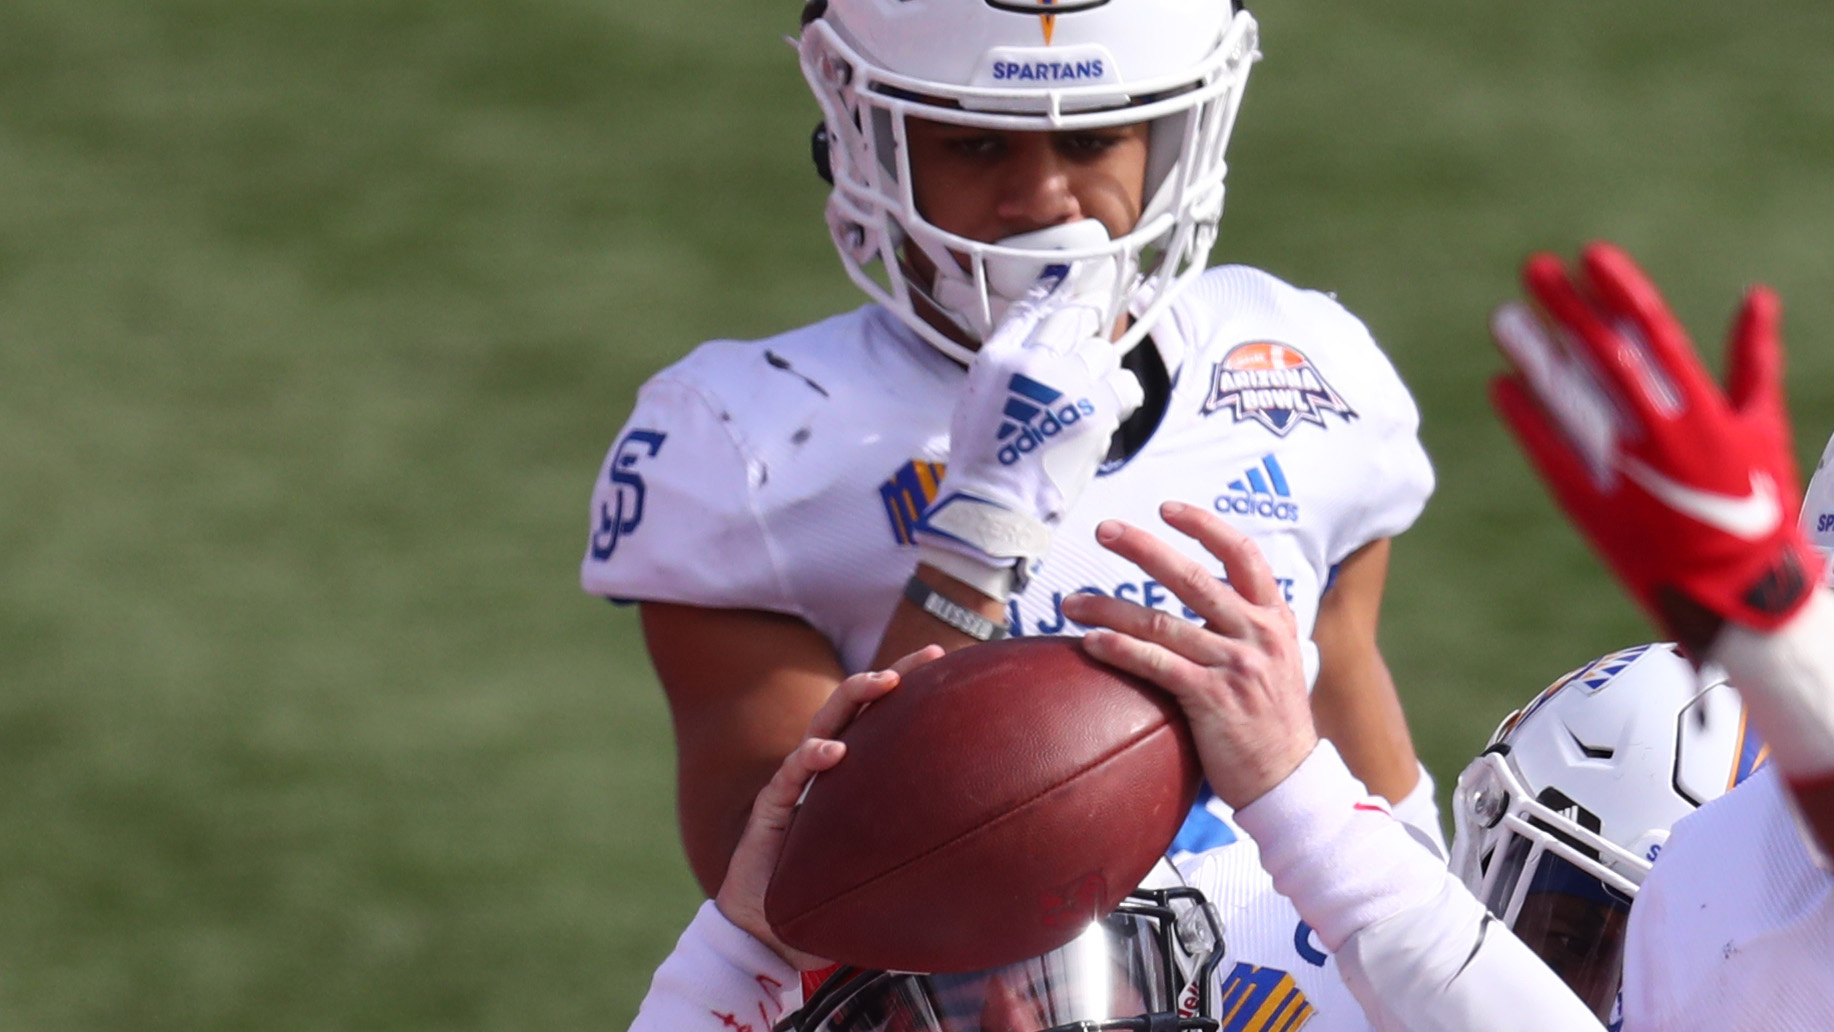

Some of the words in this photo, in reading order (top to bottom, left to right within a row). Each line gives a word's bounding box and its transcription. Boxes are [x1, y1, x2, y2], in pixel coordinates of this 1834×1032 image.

[993, 60, 1103, 80] SPARTANS
[1240, 388, 1309, 412] BOWL
[997, 398, 1094, 466] adidas
[1214, 494, 1299, 522] adidas
